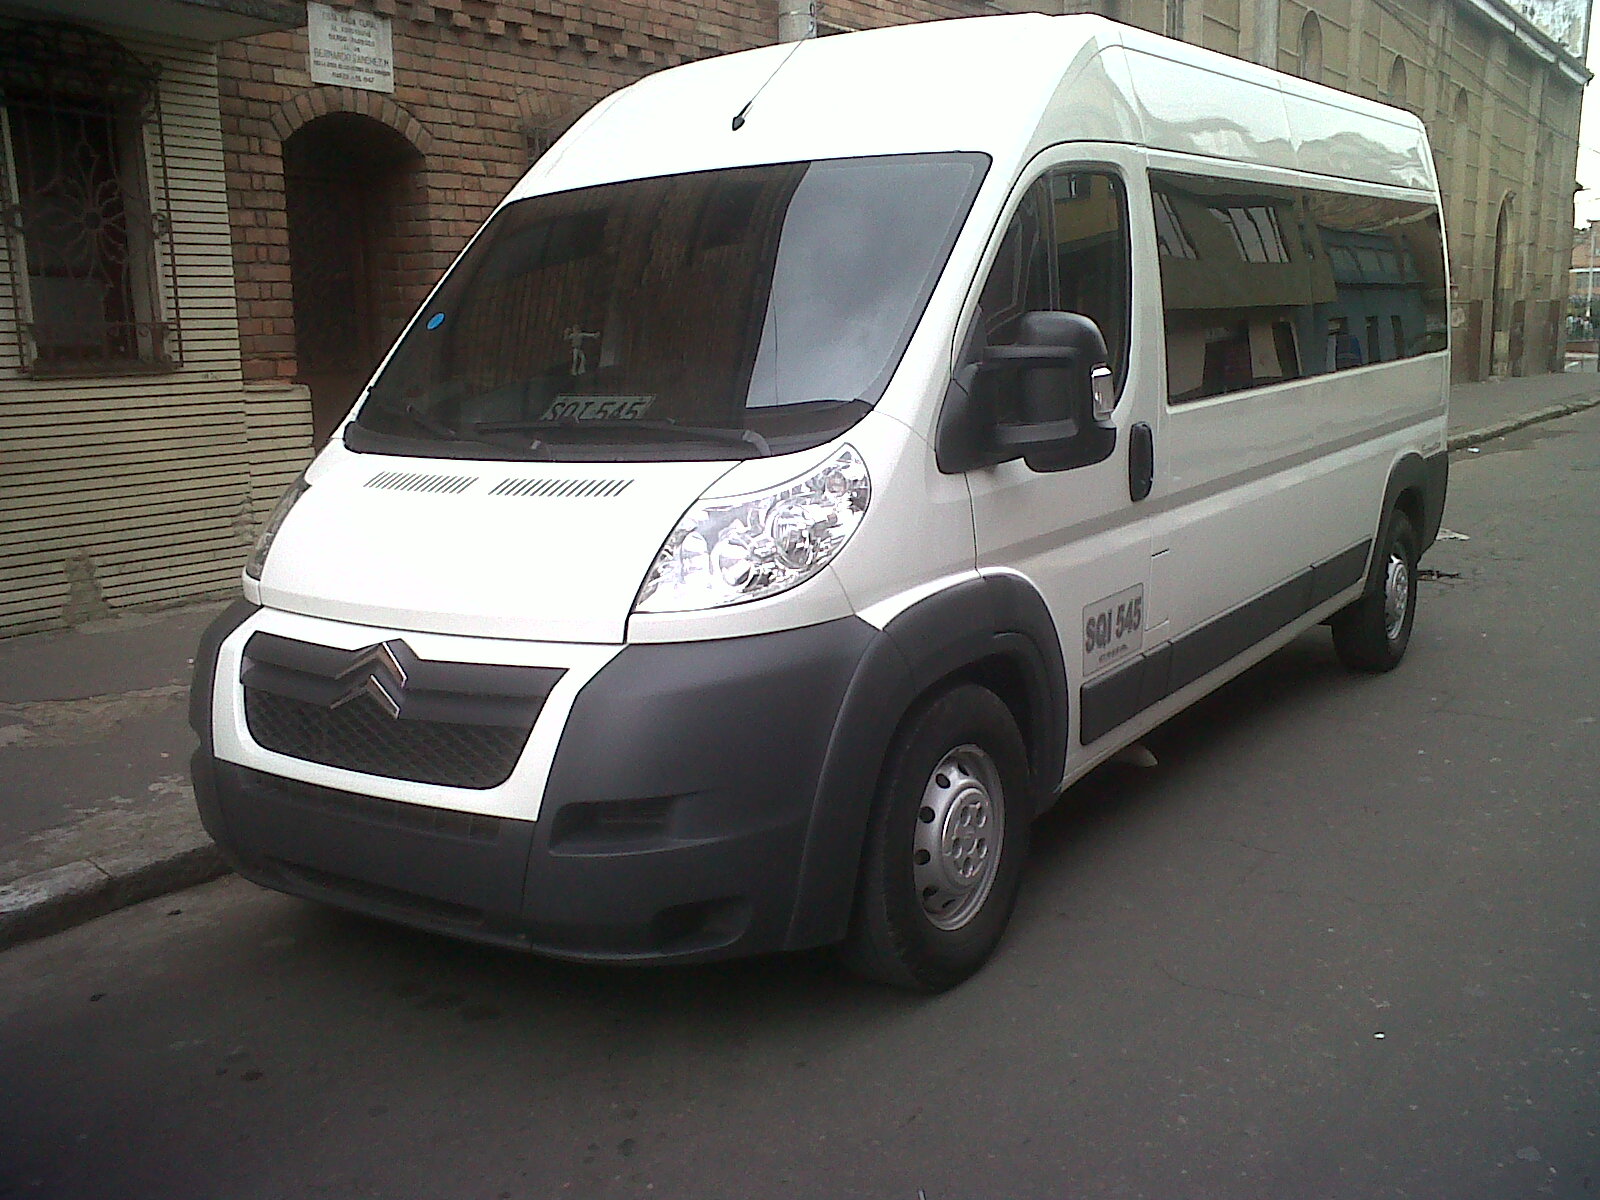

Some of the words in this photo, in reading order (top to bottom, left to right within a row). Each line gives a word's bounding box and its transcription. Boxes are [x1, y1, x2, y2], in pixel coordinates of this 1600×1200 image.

[596, 401, 646, 419] 545
[1085, 608, 1112, 654] SQI
[1115, 596, 1142, 638] 545
